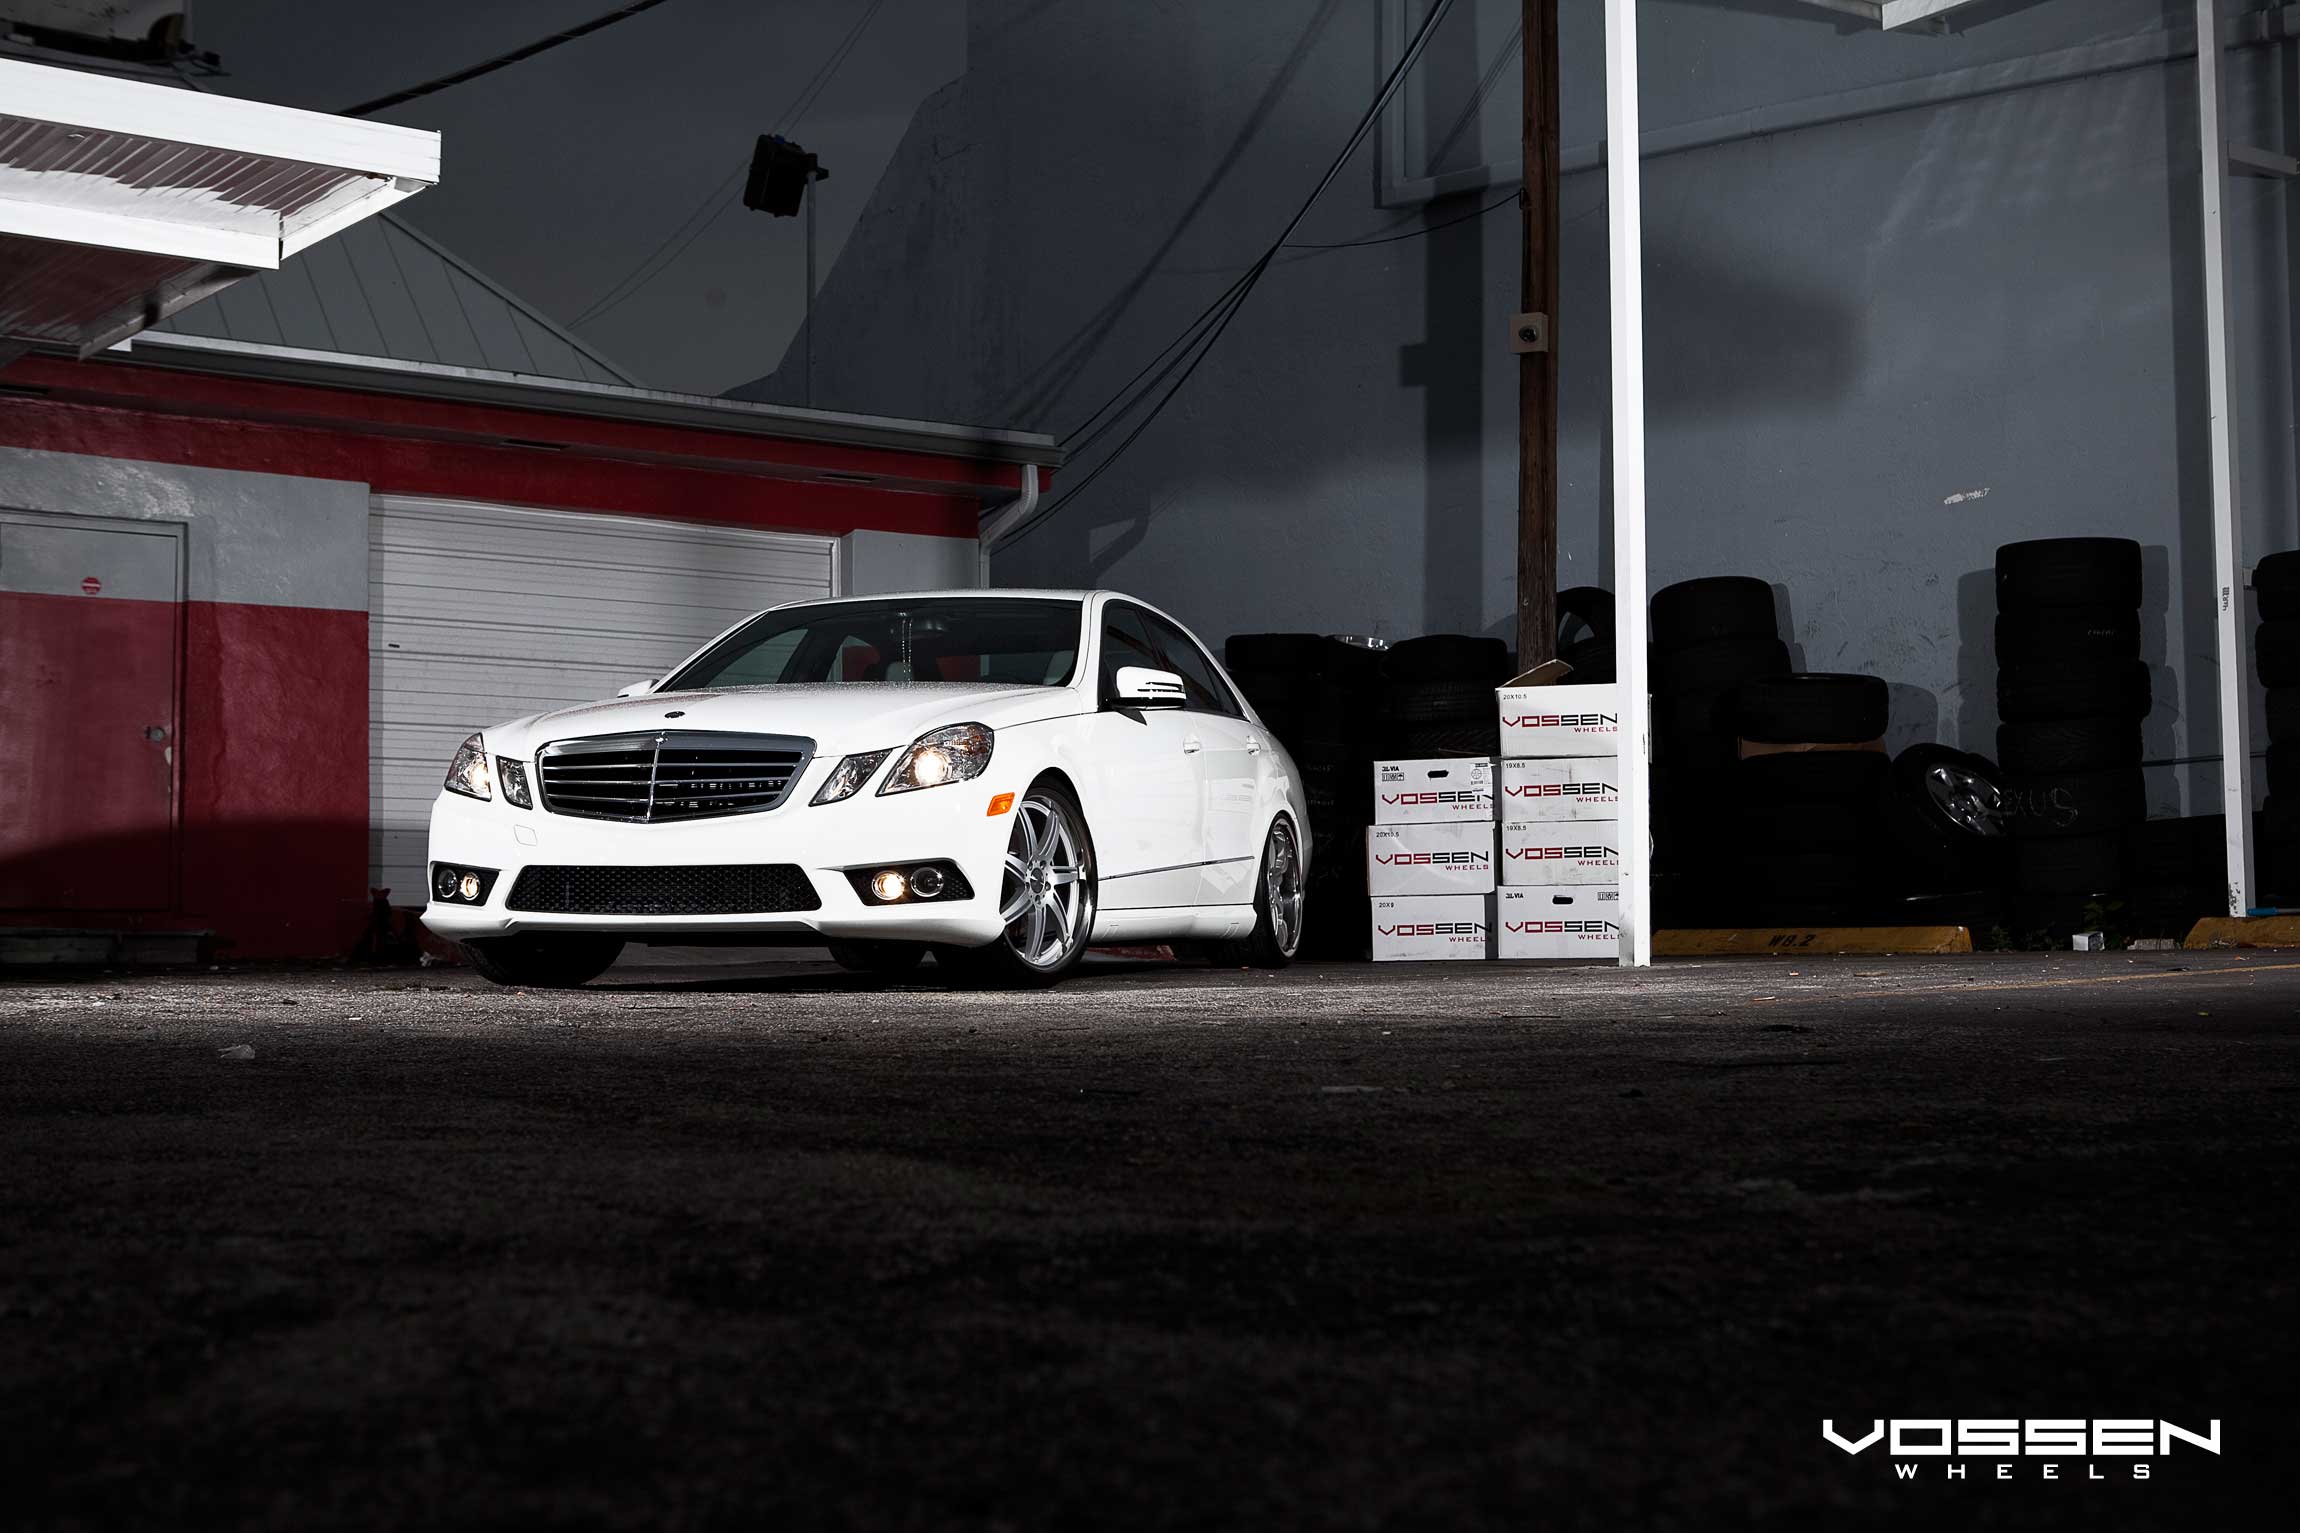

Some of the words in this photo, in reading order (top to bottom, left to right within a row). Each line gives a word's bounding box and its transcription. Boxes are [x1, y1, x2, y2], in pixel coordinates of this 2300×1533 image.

[1502, 713, 1618, 728] VOSSEN
[1375, 851, 1489, 865] VOSSEN
[1377, 922, 1493, 936] VOSSEN
